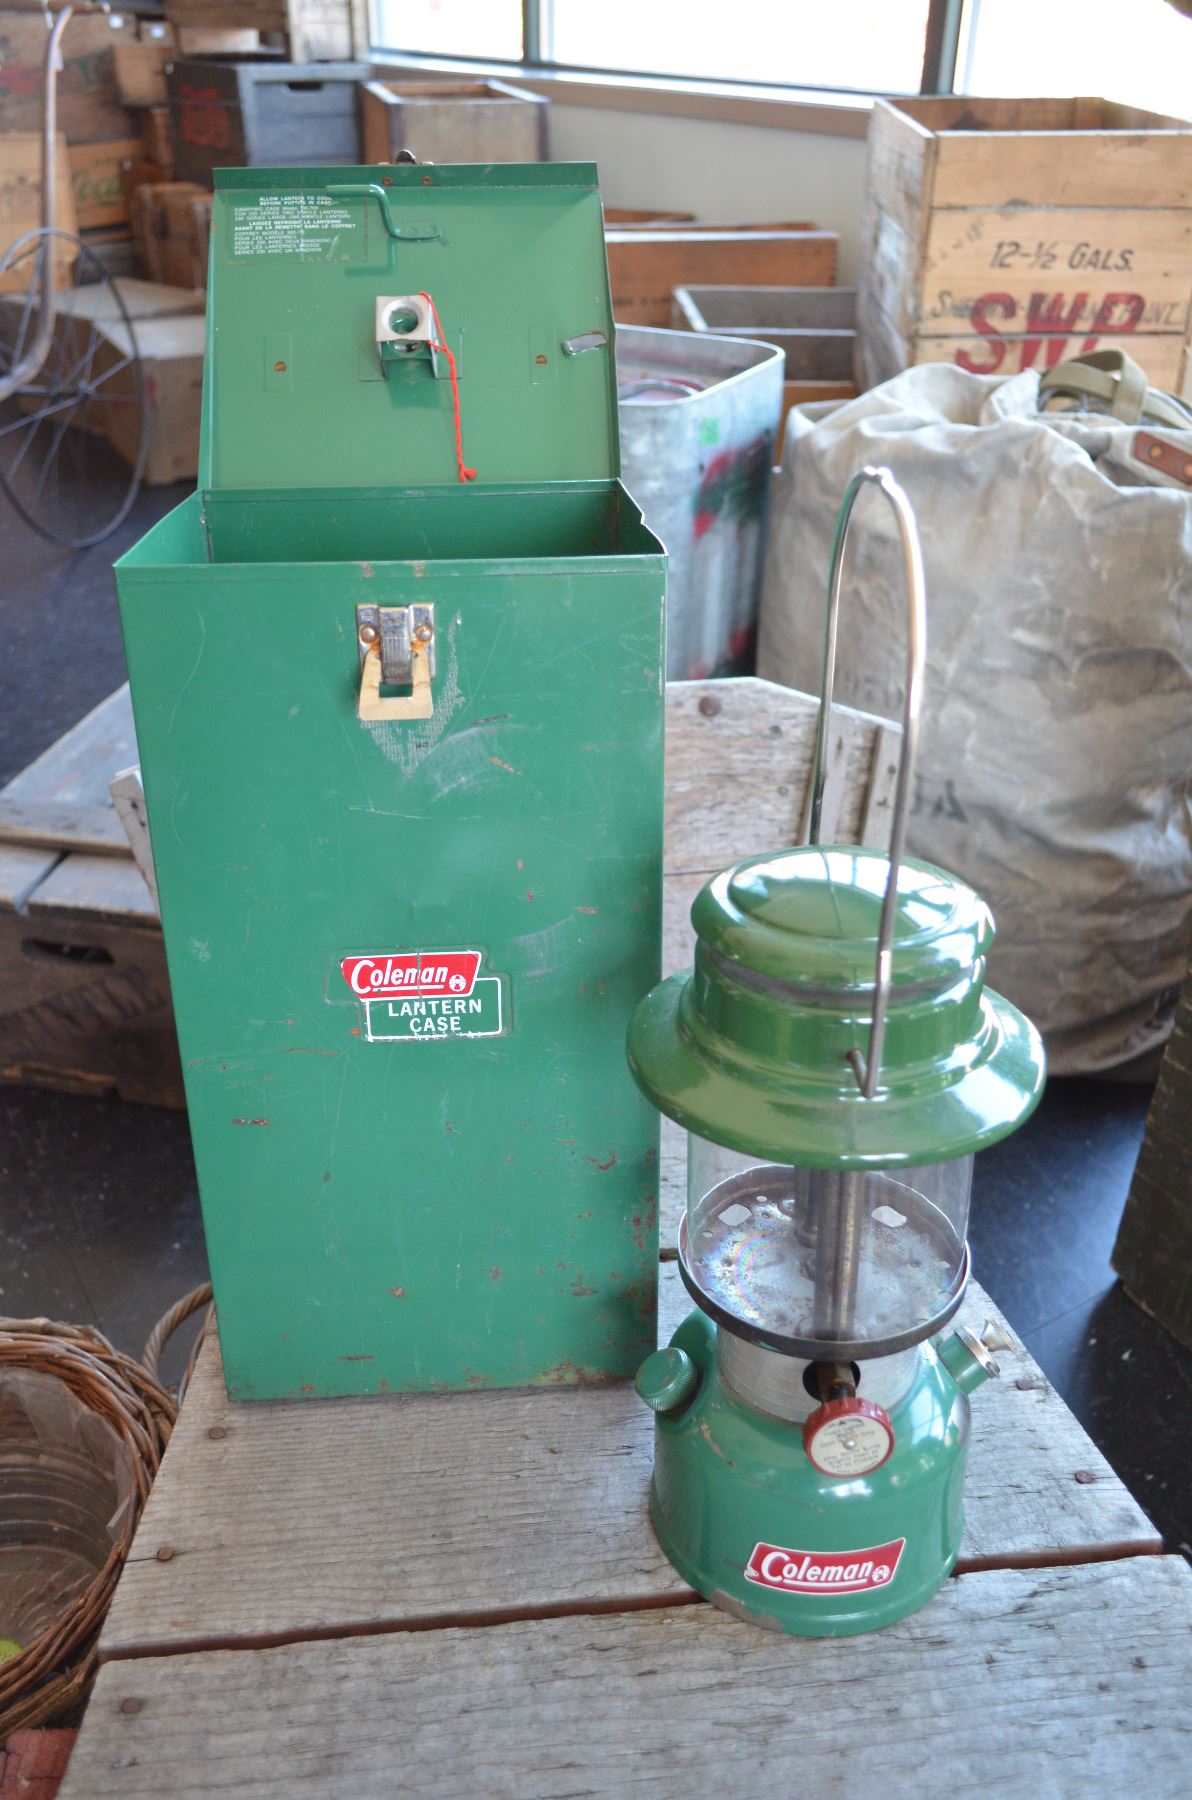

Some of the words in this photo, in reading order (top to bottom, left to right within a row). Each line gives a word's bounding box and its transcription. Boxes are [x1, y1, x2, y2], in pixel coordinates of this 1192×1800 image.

[350, 959, 449, 994] Coleman
[388, 999, 482, 1017] LANTERN
[409, 1016, 461, 1033] CASE
[761, 1551, 873, 1583] Coleman
